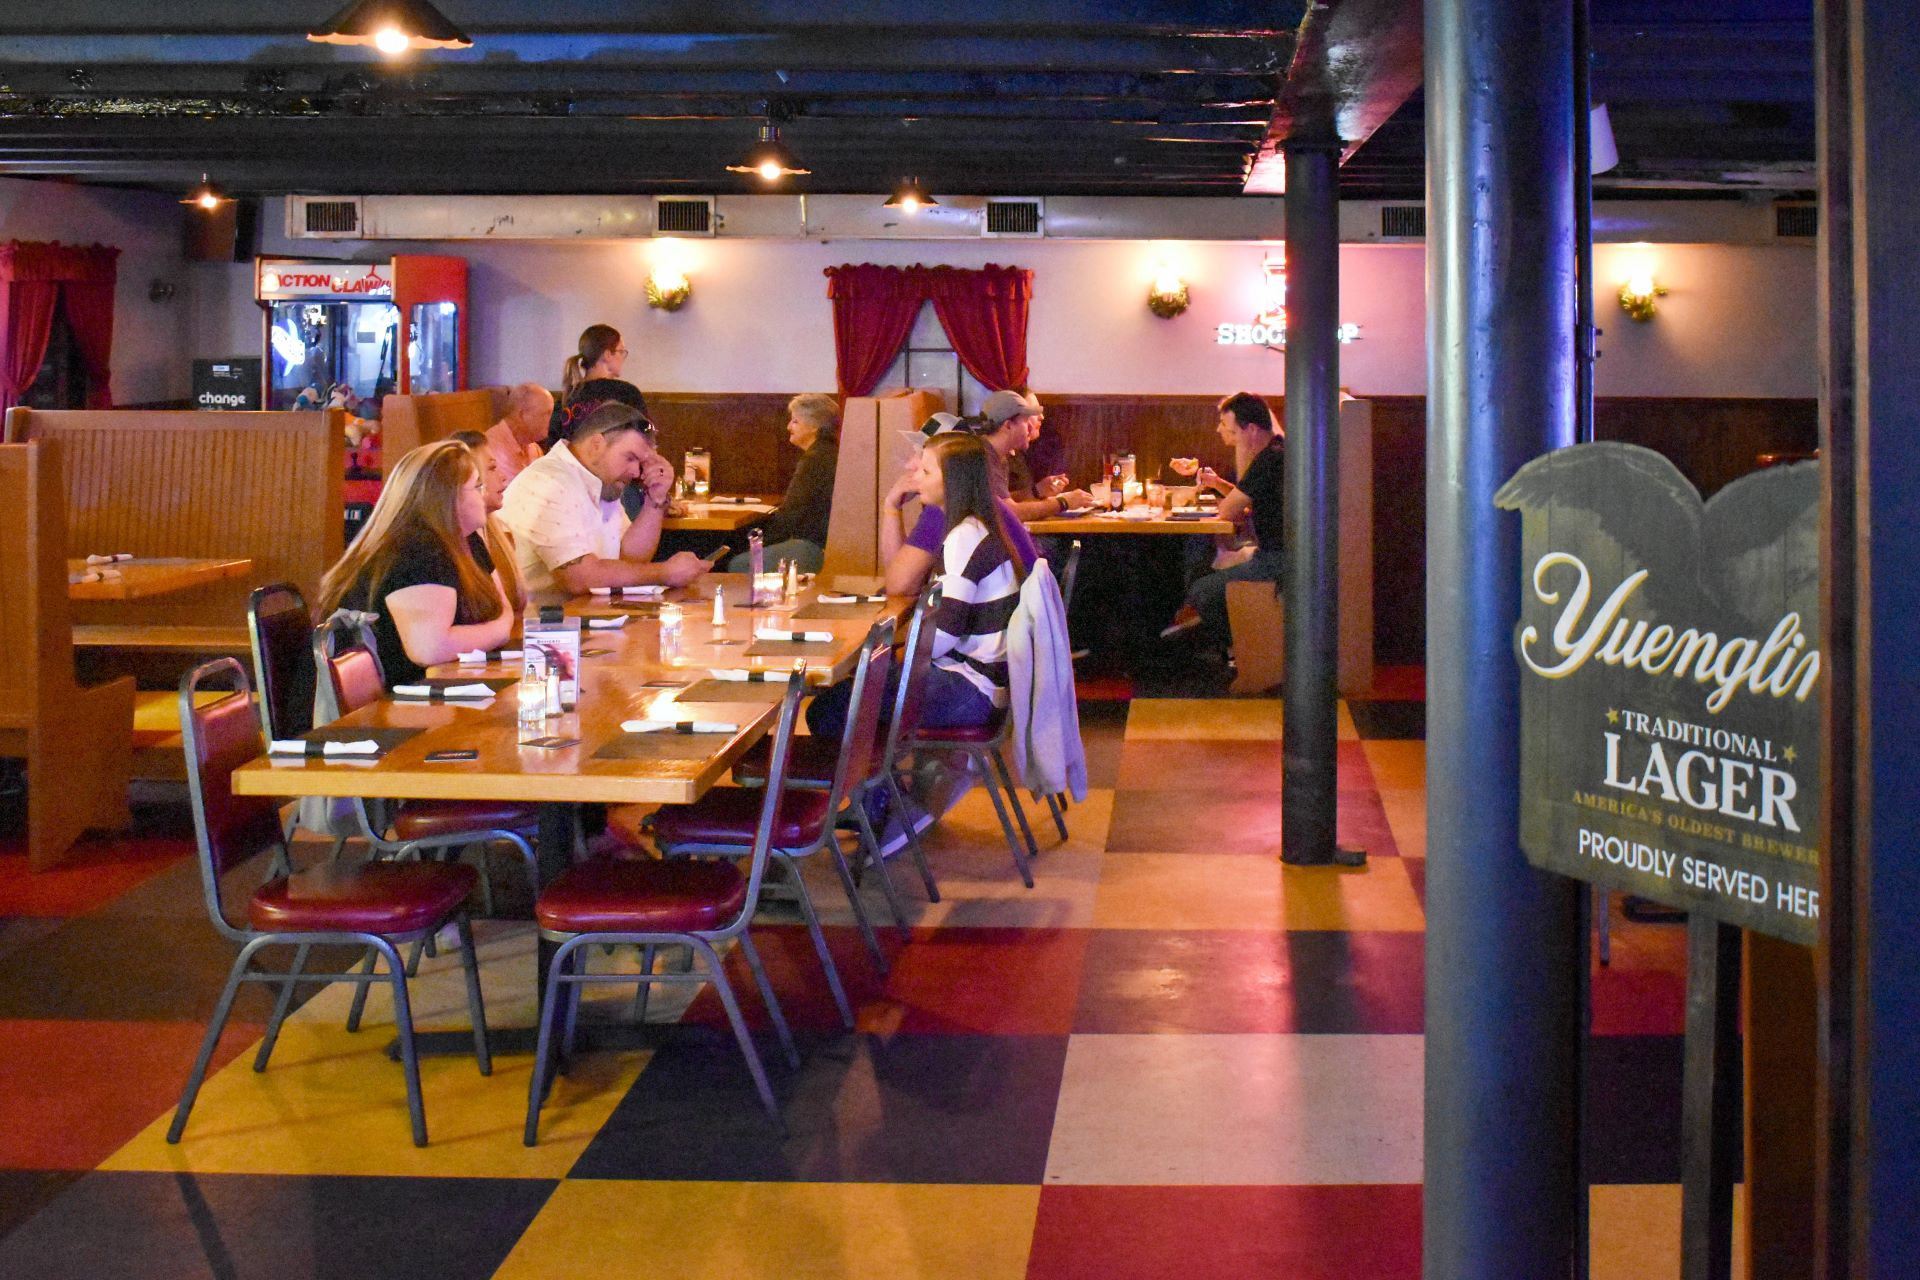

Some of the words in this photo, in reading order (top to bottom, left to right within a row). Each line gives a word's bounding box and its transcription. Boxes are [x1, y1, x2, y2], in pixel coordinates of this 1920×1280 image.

[1217, 323, 1286, 345] SHOC
[198, 391, 246, 407] change
[1622, 709, 1777, 762] TRADITIONAL
[1603, 732, 1801, 833] LAGER
[1573, 791, 1662, 825] AMERICA'S
[1668, 814, 1735, 844] OLDEST
[1579, 828, 1676, 878] PROUDLY
[1682, 856, 1769, 904] SERVED
